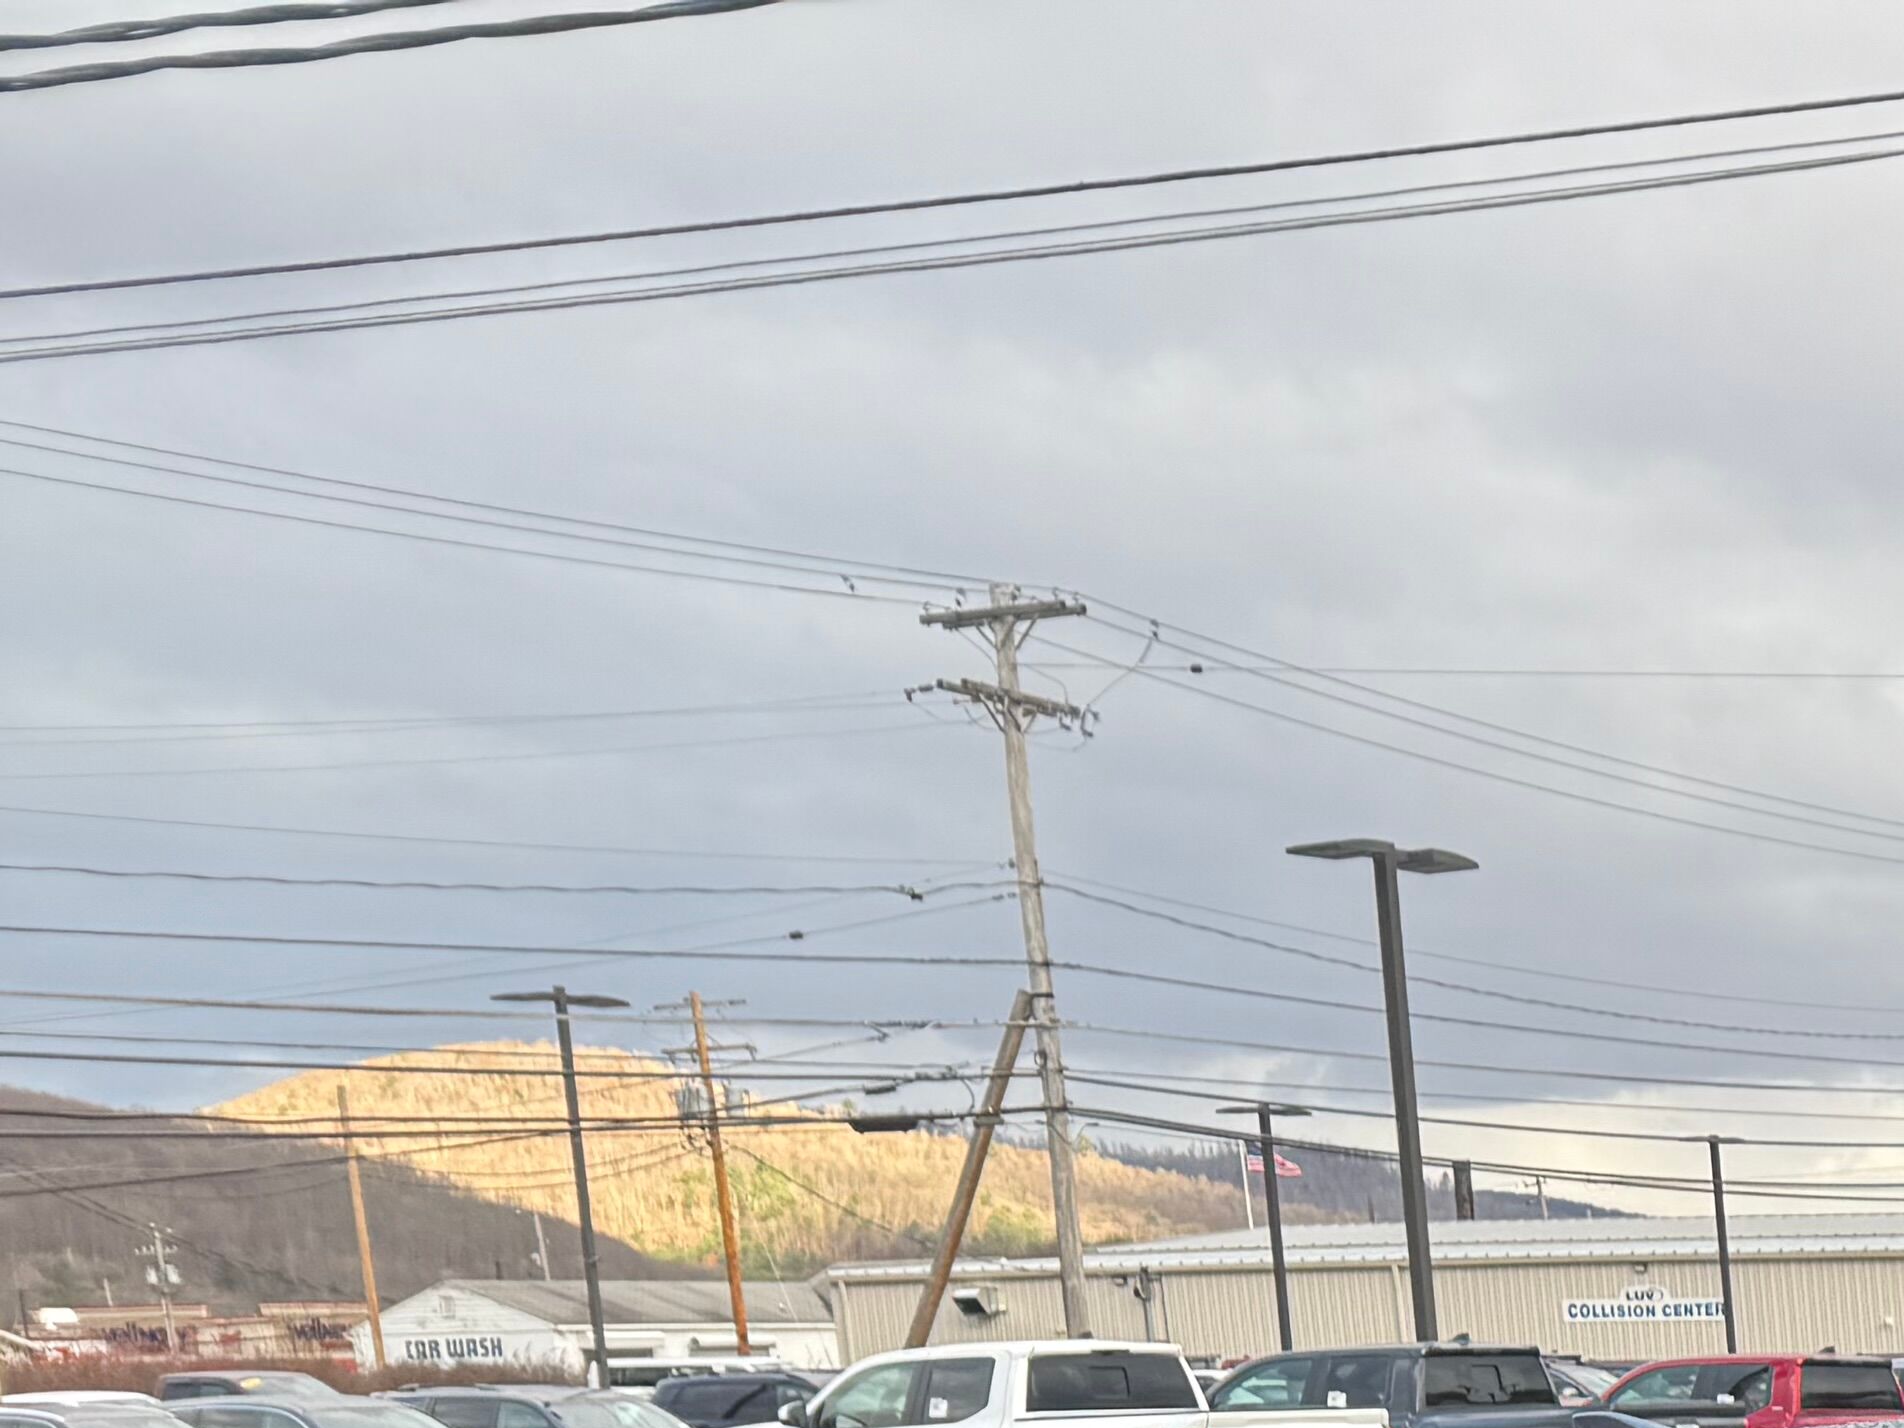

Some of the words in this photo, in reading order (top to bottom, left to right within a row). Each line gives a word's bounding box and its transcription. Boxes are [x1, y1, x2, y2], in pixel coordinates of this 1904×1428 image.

[1568, 1303, 1656, 1318] COLLISION
[404, 1339, 442, 1360] CAR
[445, 1337, 503, 1358] WASH
